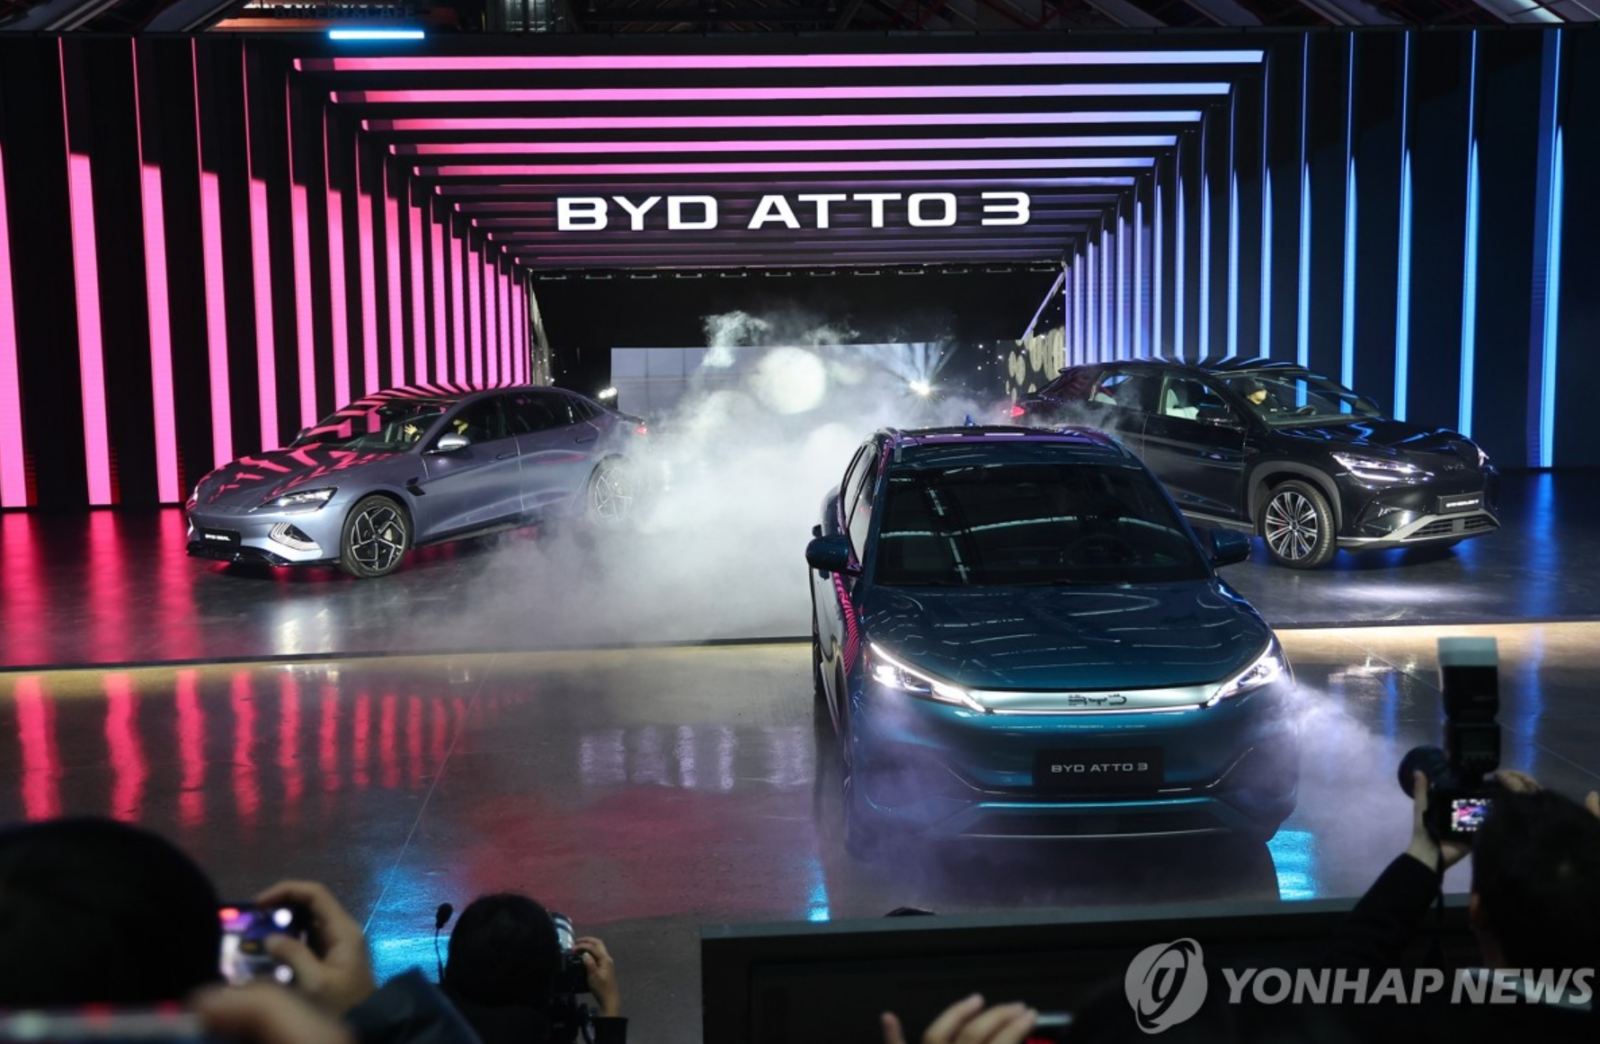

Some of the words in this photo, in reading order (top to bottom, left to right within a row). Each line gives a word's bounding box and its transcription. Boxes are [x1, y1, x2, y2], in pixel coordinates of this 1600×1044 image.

[557, 195, 718, 231] BYD
[747, 192, 957, 229] ATTO
[981, 191, 1030, 226] 3
[1067, 693, 1127, 706] BYD
[1051, 764, 1085, 773] BYD
[1090, 763, 1134, 772] ATTO
[1137, 762, 1148, 771] 3
